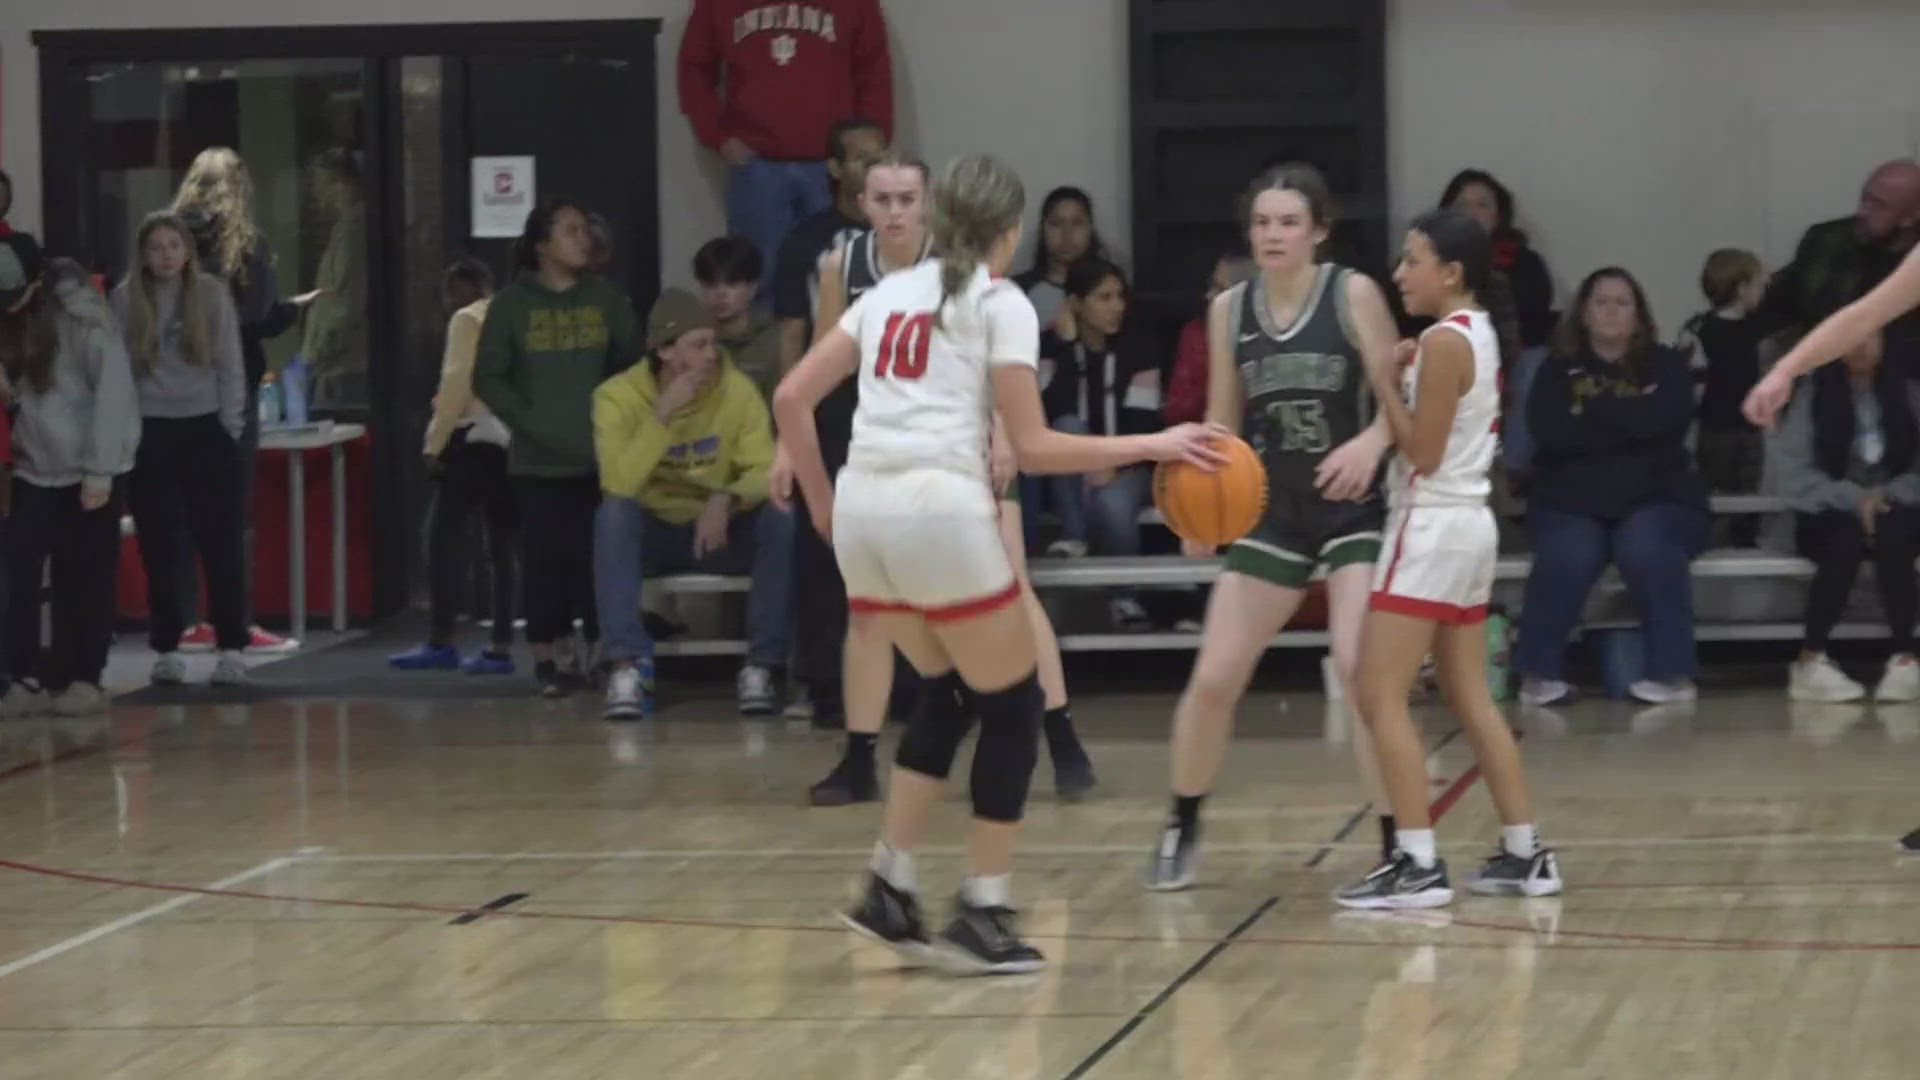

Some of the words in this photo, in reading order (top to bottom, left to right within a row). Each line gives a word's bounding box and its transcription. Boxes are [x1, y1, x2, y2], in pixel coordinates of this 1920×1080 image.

[733, 4, 837, 43] INDIANA
[874, 310, 934, 381] 10
[1266, 400, 1332, 453] 15
